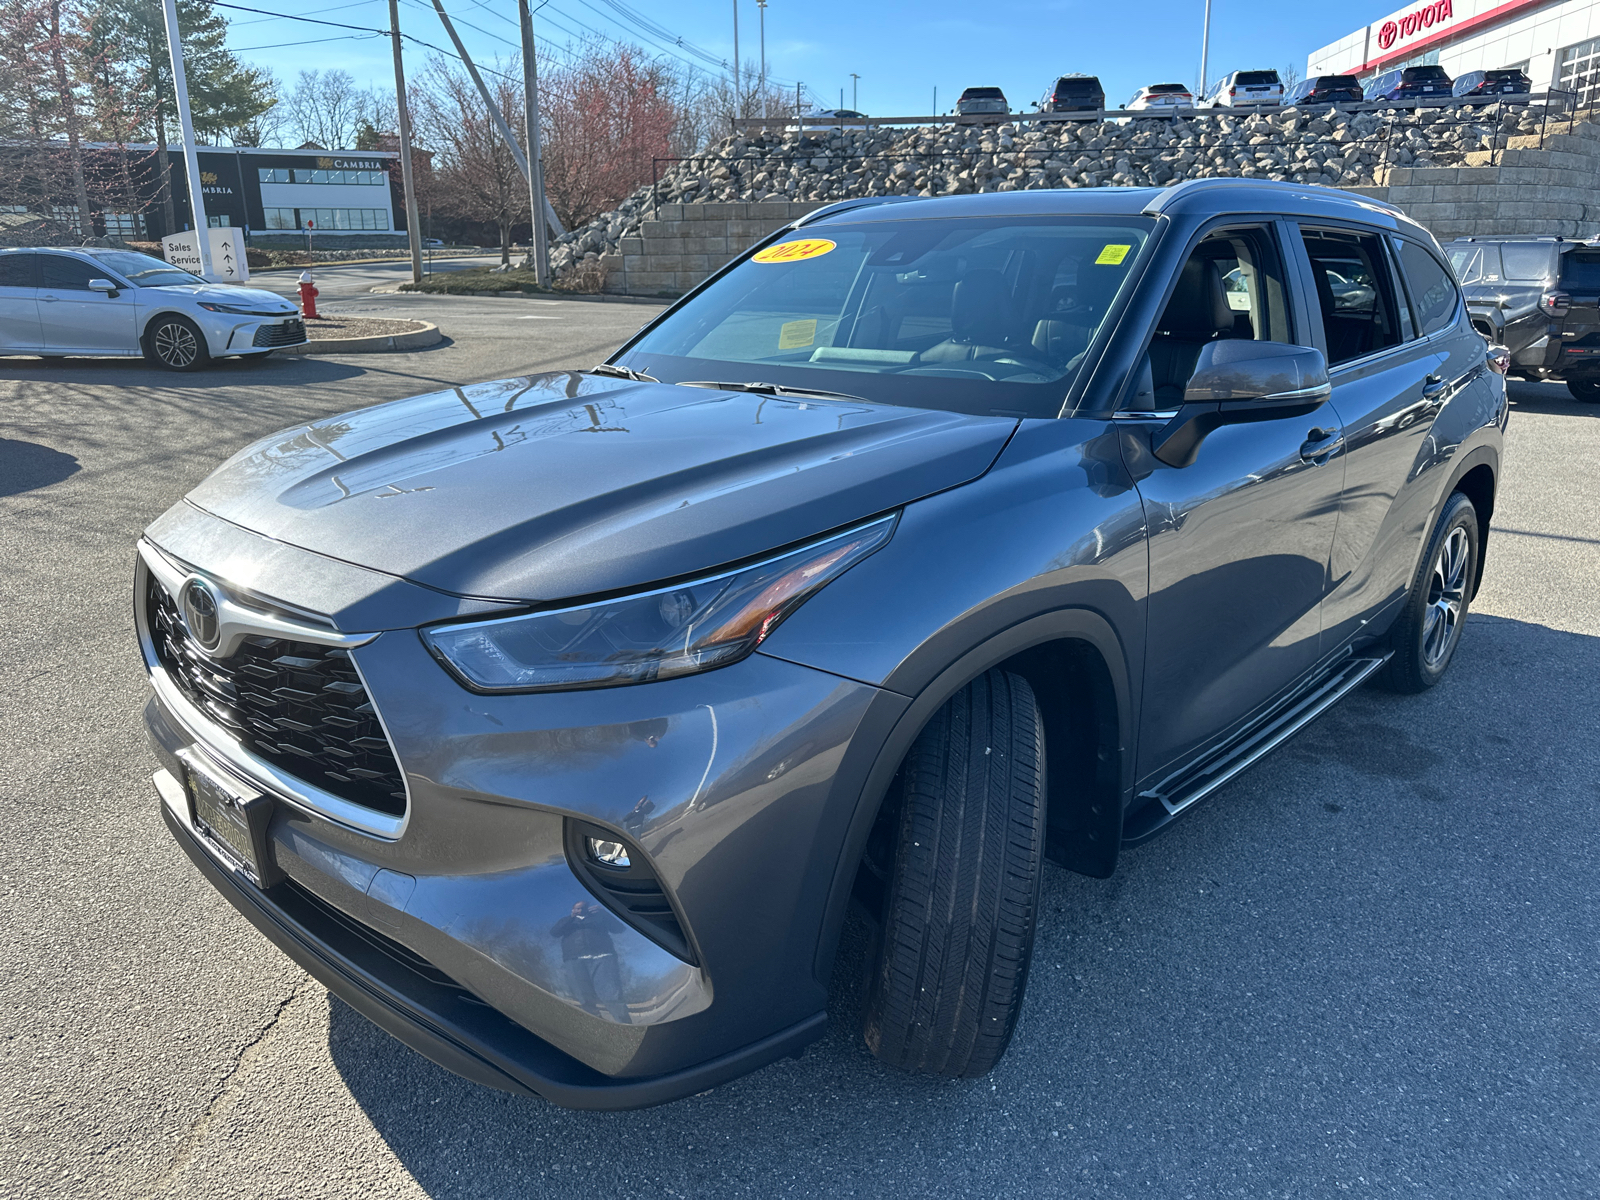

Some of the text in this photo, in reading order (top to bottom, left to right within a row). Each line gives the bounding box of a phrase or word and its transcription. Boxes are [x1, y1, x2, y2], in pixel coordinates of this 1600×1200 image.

[1398, 0, 1453, 39] TOYOTA
[334, 160, 382, 169] CAMBRIA
[168, 243, 192, 252] Sales
[758, 243, 828, 260] 2024
[170, 256, 200, 264] Service
